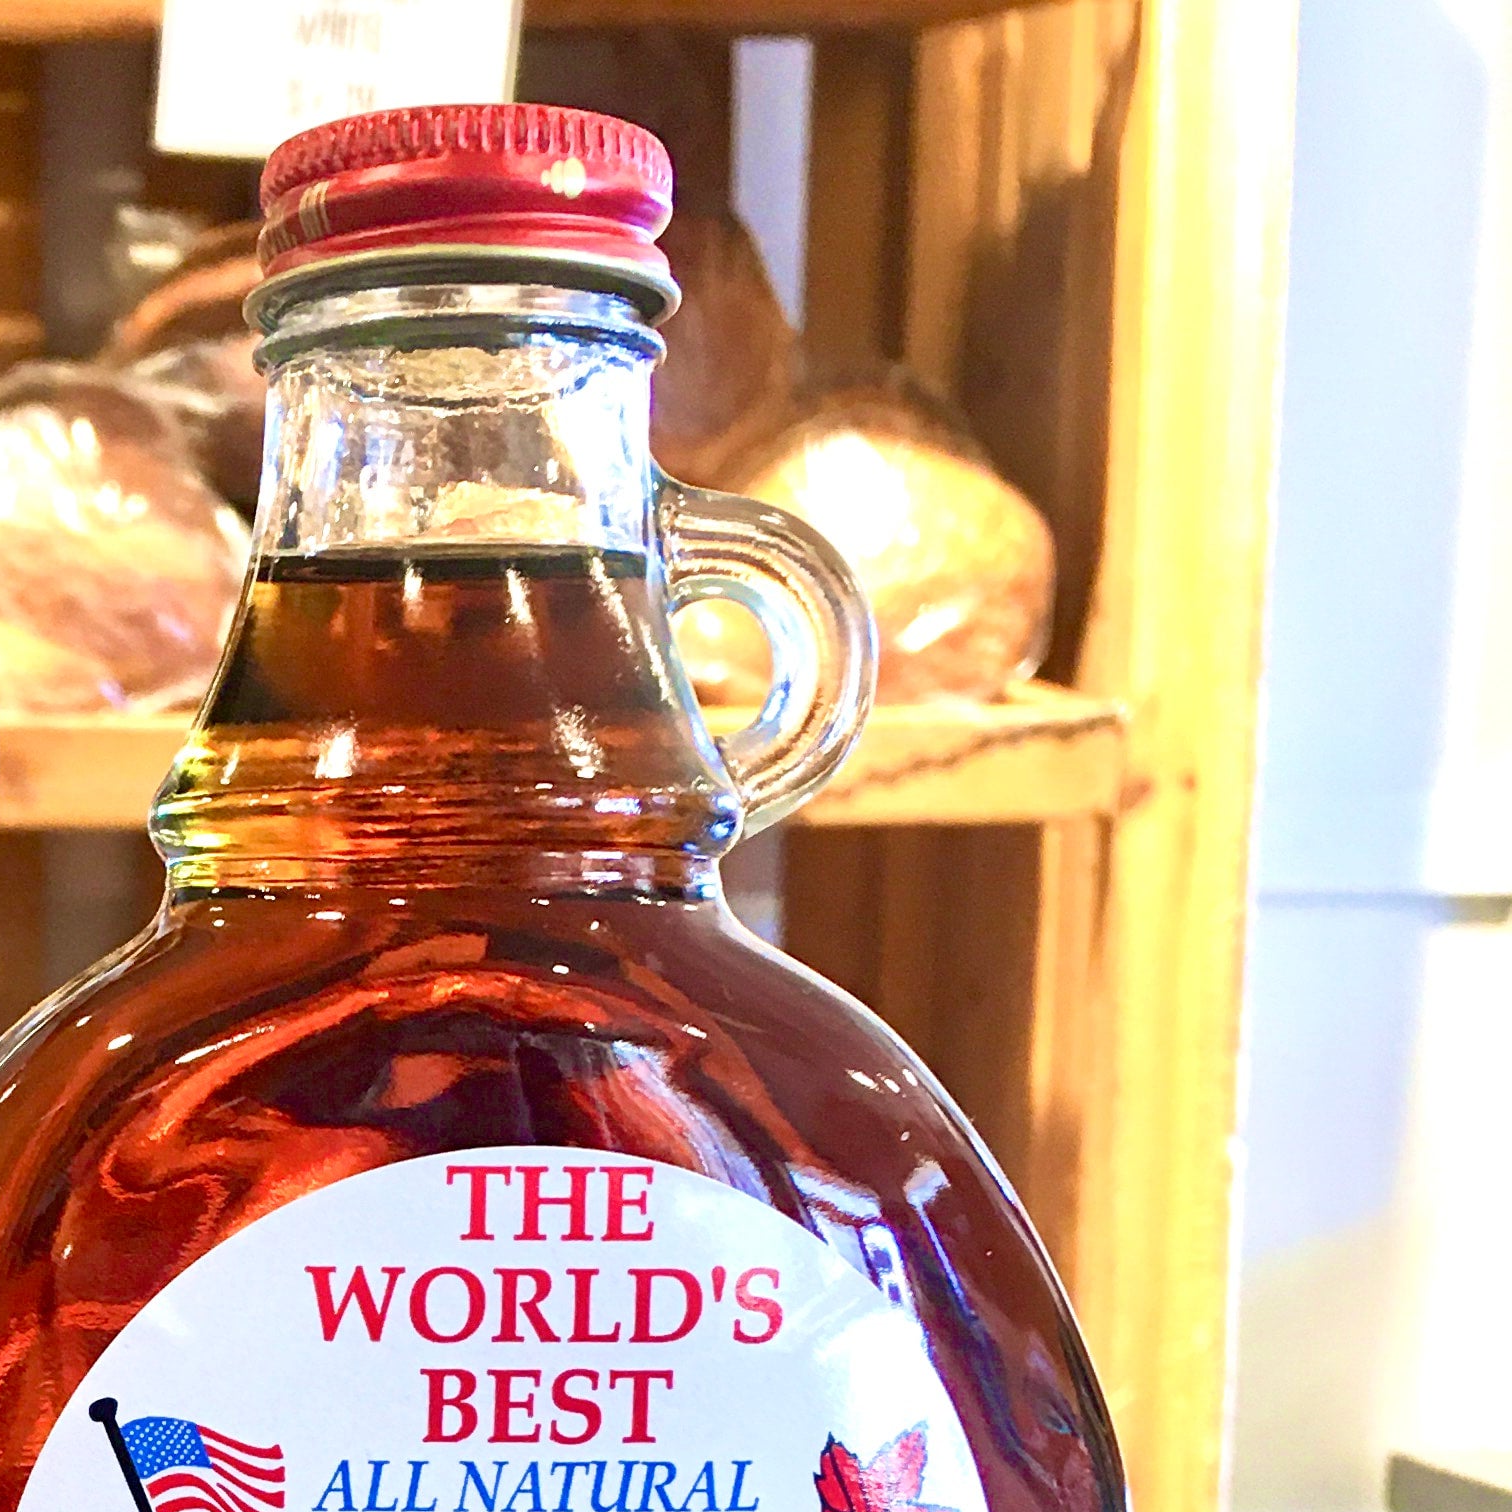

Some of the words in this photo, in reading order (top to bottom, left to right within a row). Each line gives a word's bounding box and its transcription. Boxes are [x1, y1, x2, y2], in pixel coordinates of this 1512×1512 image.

[445, 1164, 655, 1242] THE
[304, 1265, 784, 1345] WORLD'S
[419, 1368, 674, 1445] BEST
[311, 1460, 438, 1512] ALL
[453, 1460, 760, 1512] NATURAL
